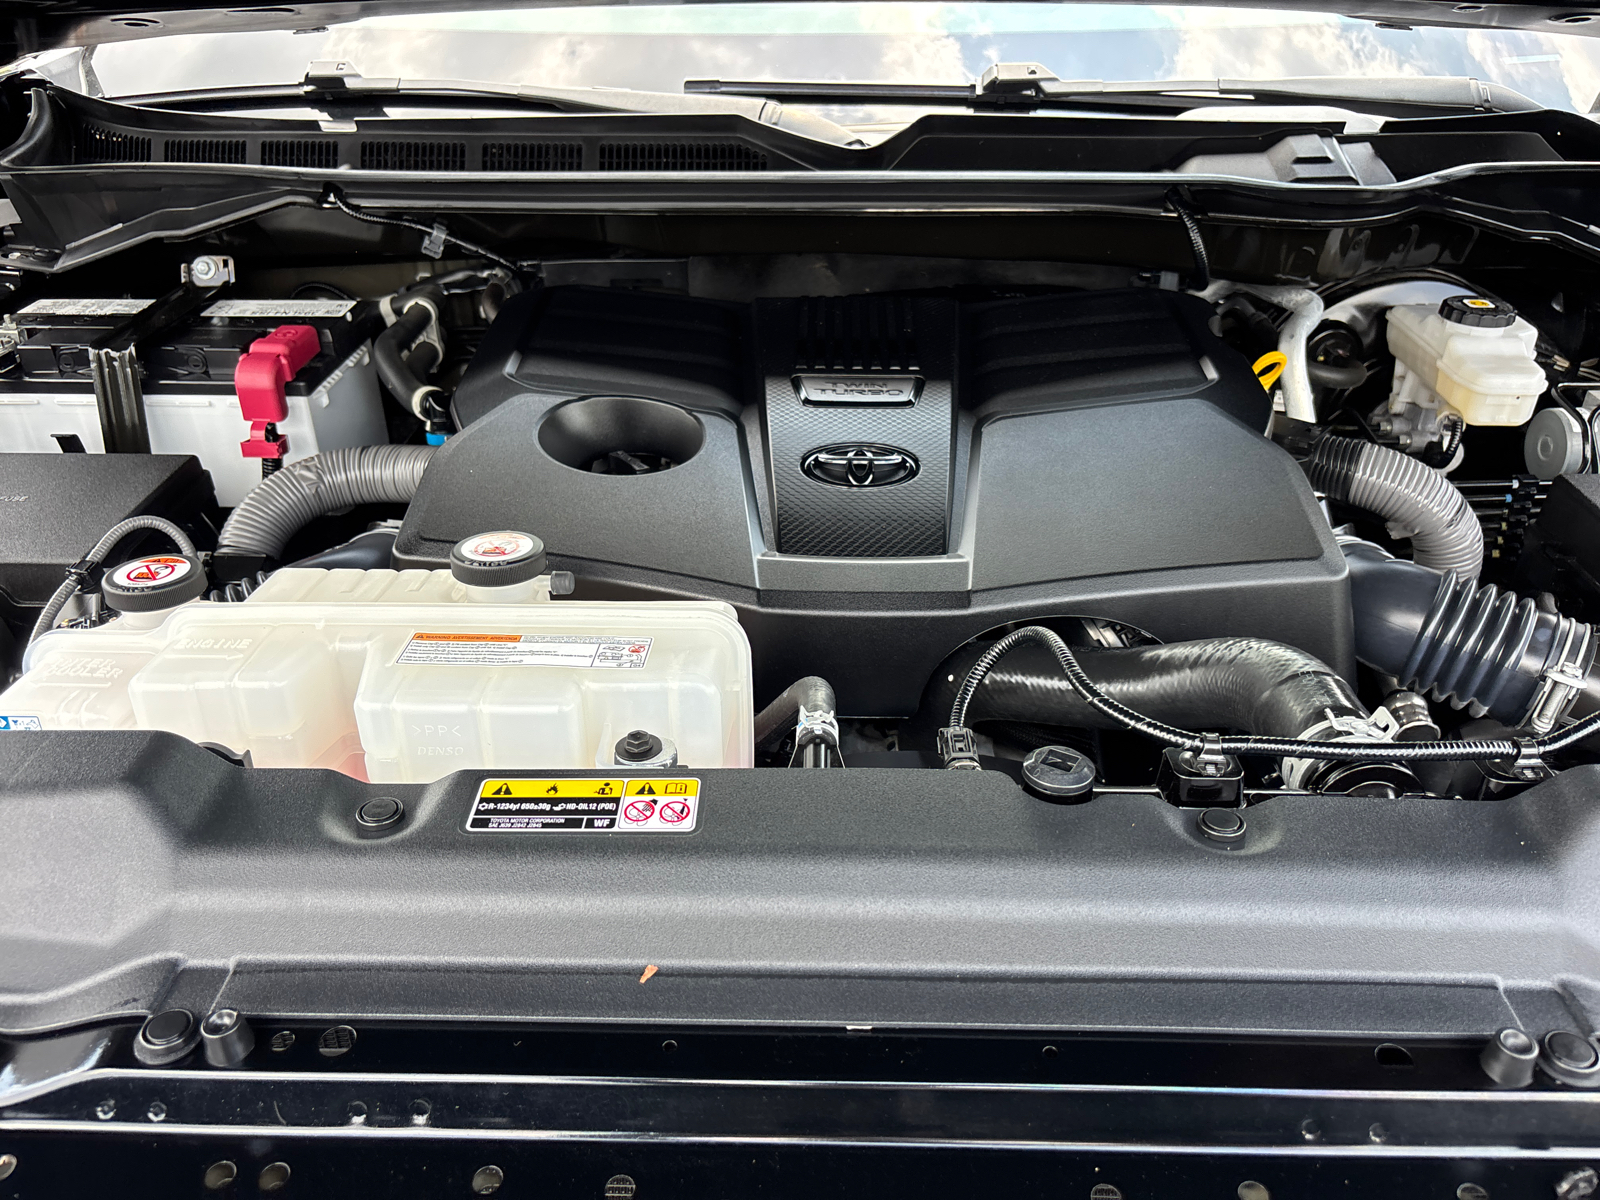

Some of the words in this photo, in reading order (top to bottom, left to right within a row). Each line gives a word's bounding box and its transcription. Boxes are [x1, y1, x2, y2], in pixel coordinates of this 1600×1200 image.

[173, 638, 253, 650] ENGINE
[411, 724, 462, 737] >PP<
[417, 746, 464, 756] DENSO
[488, 802, 520, 812] R-1234yf
[566, 802, 597, 811] ND-OIL12
[598, 802, 616, 811] (POE)
[593, 818, 611, 828] WF
